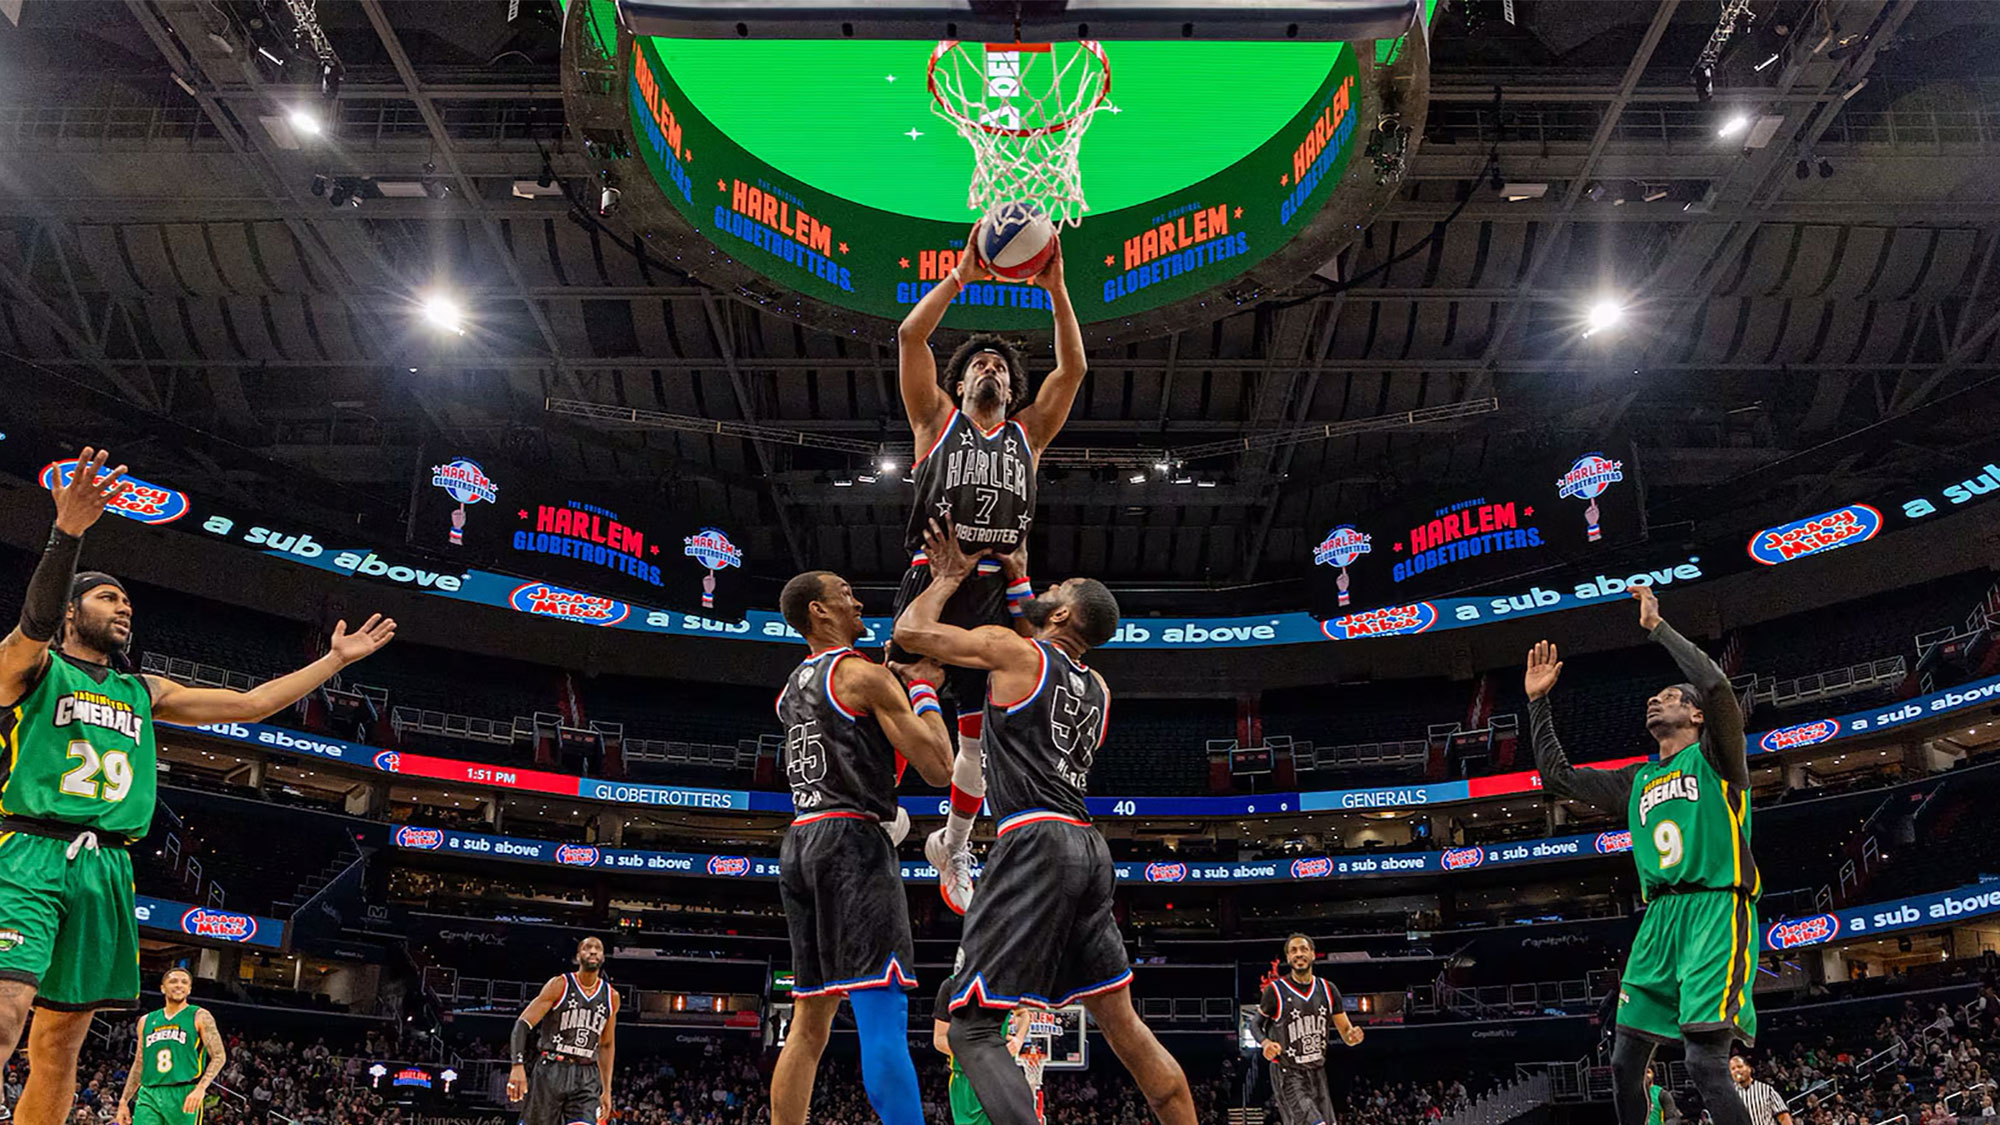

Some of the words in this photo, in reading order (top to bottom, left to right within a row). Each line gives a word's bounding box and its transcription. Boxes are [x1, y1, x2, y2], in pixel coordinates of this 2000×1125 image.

[1293, 76, 1349, 185] HARLEM
[732, 178, 832, 258] HARLEM
[1124, 204, 1228, 271] HARLEM
[441, 464, 489, 490] HARLEM
[1564, 460, 1613, 485] HARLEM
[568, 500, 581, 509] THE
[584, 503, 618, 521] ORIGINAL
[974, 487, 999, 525] 7
[1436, 507, 1448, 517] THE
[1451, 497, 1486, 512] ORIGINAL
[1902, 498, 1936, 518] a
[537, 505, 644, 558] HARLEM
[1410, 502, 1517, 555] HARLEM
[1765, 509, 1858, 550] Jersey
[203, 514, 234, 535] a
[244, 525, 323, 558] sub
[333, 553, 461, 592] above
[692, 535, 734, 556] HARLEM
[1320, 533, 1363, 553] HARLEM
[527, 587, 613, 610] Jersey
[1455, 603, 1480, 621] a
[1490, 587, 1561, 615] sub
[1574, 562, 1702, 599] above
[646, 611, 670, 627] a
[1336, 605, 1420, 626] Jersey
[1108, 623, 1150, 642] ub
[1162, 623, 1275, 643] above
[1851, 719, 1868, 730] a
[1876, 704, 1922, 725] sub
[1770, 722, 1826, 742] Jersey
[258, 731, 342, 757] above
[59, 739, 133, 802] 29
[467, 768, 491, 781] 1:51
[495, 772, 516, 784] PM
[595, 785, 732, 809] GLOBETROTTERS
[1342, 789, 1427, 808] GENERALS
[1113, 801, 1136, 815] 40
[449, 837, 459, 849] a
[463, 838, 490, 852] sub
[1489, 851, 1498, 861] a
[1502, 847, 1528, 860] sub
[1653, 819, 1683, 869] 9
[605, 856, 614, 865] a
[618, 855, 644, 867] sub
[755, 865, 764, 874] a
[901, 868, 910, 876] a
[914, 866, 939, 877] sub
[1339, 862, 1348, 872] a
[1352, 858, 1377, 871] sub
[1192, 869, 1200, 878] a
[1204, 867, 1229, 879] sub
[192, 911, 247, 929] Jersey
[1777, 917, 1826, 938] Jersey
[1850, 918, 1866, 932] a
[1874, 906, 1920, 927] sub
[574, 1028, 590, 1047] 5
[157, 1049, 172, 1073] 8
